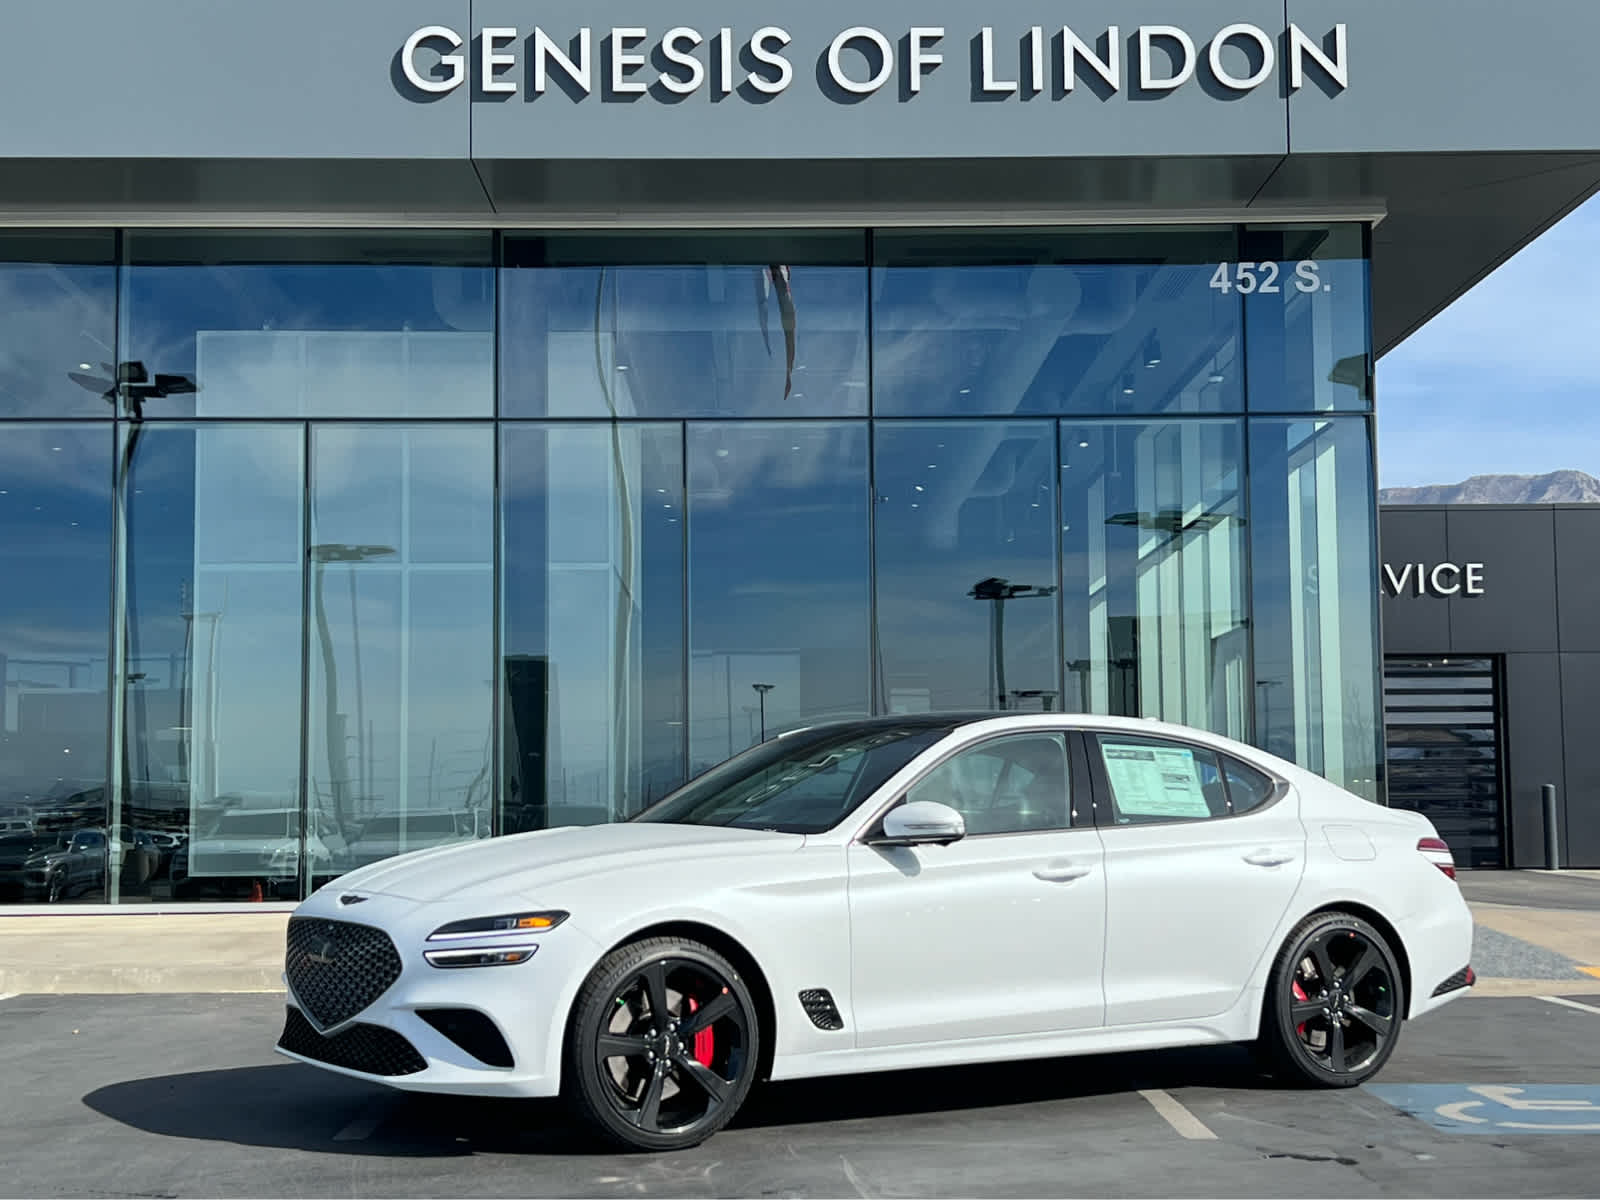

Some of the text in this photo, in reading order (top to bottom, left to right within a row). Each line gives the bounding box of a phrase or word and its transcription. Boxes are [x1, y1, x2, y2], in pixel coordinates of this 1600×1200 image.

[401, 23, 1348, 94] GENESIS OF LINDON
[1209, 260, 1331, 294] 452 S.
